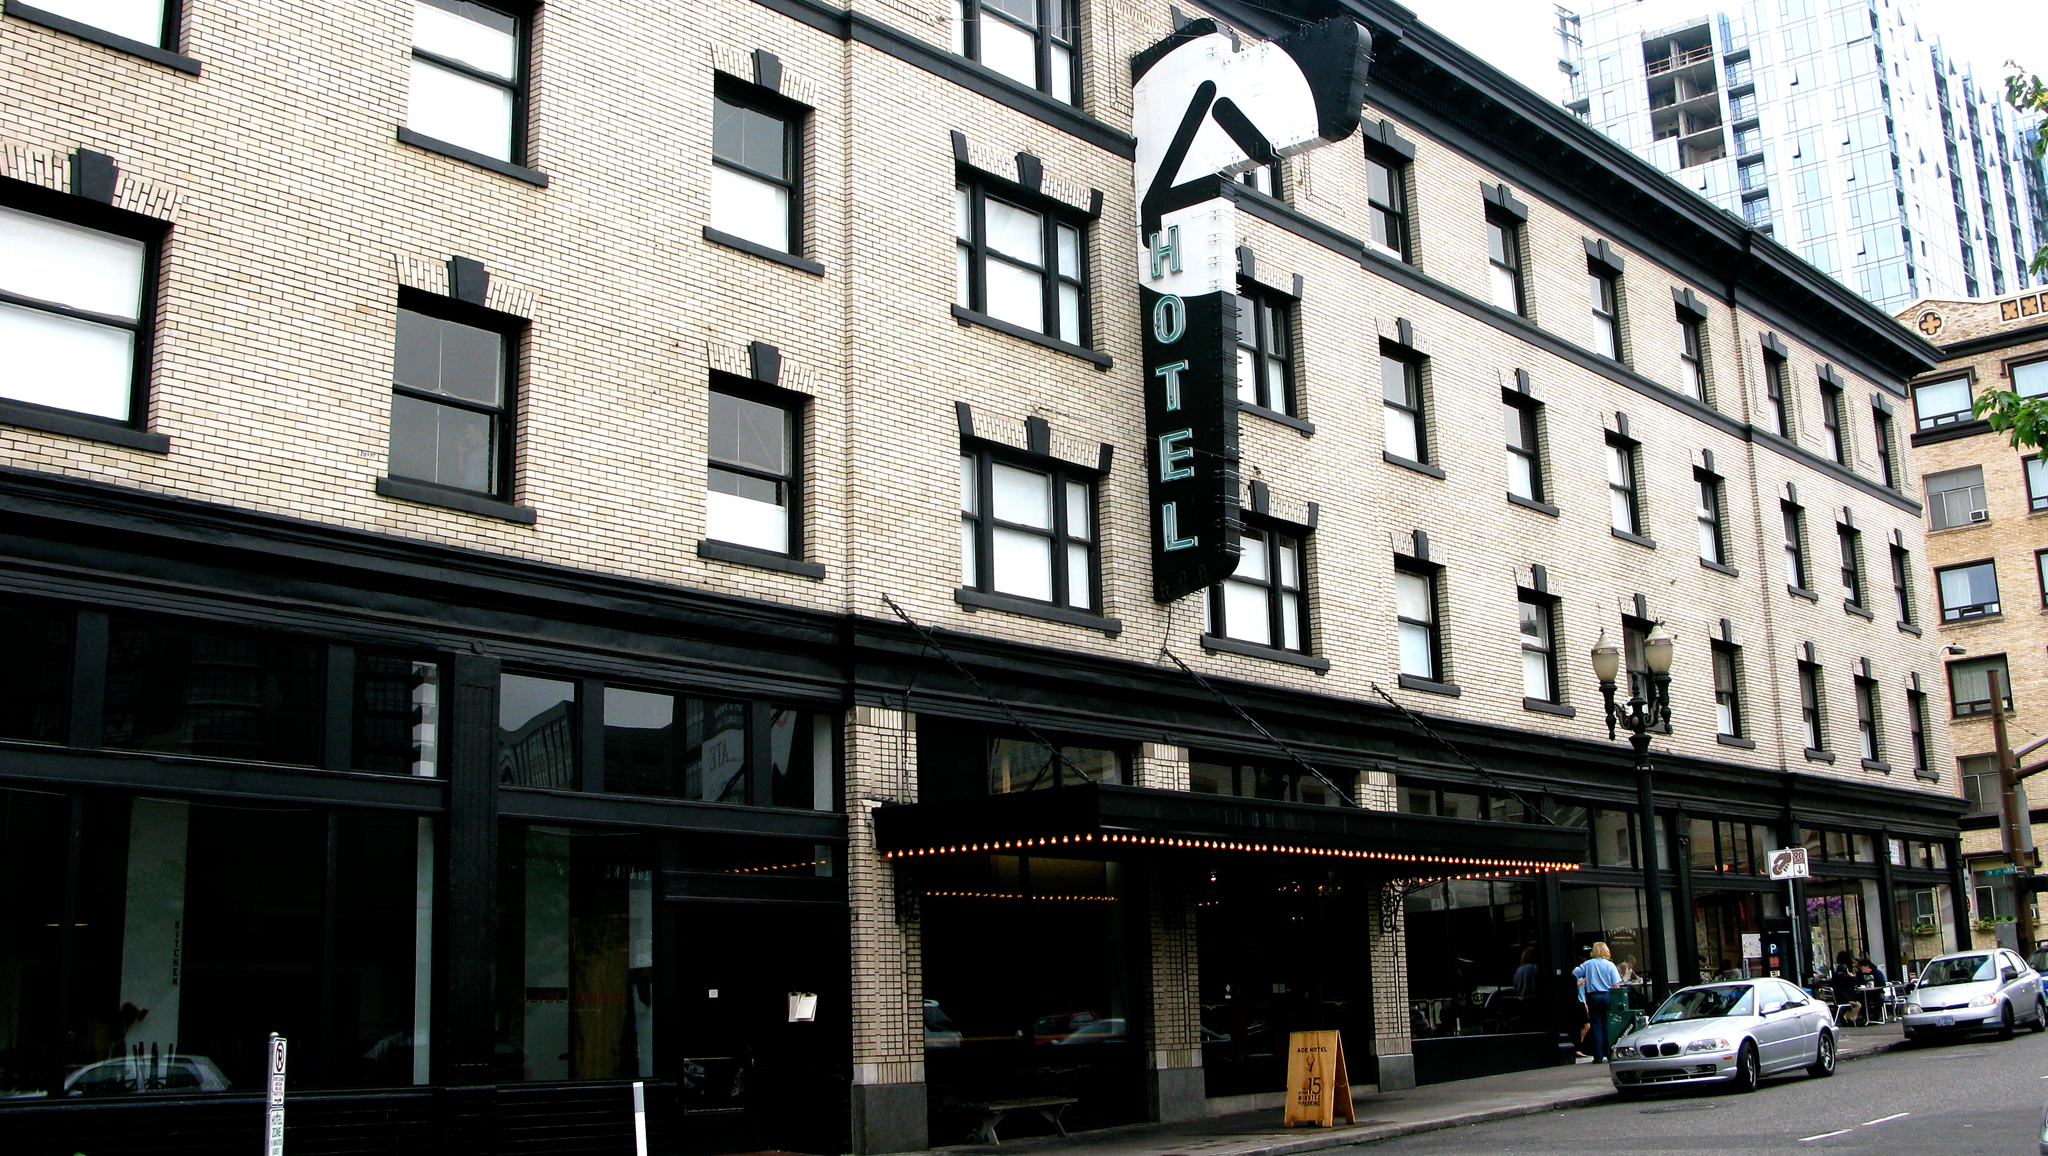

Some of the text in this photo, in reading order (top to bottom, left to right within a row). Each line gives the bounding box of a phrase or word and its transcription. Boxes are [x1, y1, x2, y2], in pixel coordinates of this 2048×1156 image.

[1149, 224, 1199, 553] HOTEL
[1793, 850, 1804, 861] 90
[172, 921, 180, 986] KITCHEN
[1770, 943, 1777, 954] P
[520, 991, 627, 1004] CLYDE COMMON
[1308, 1078, 1321, 1094] 15
